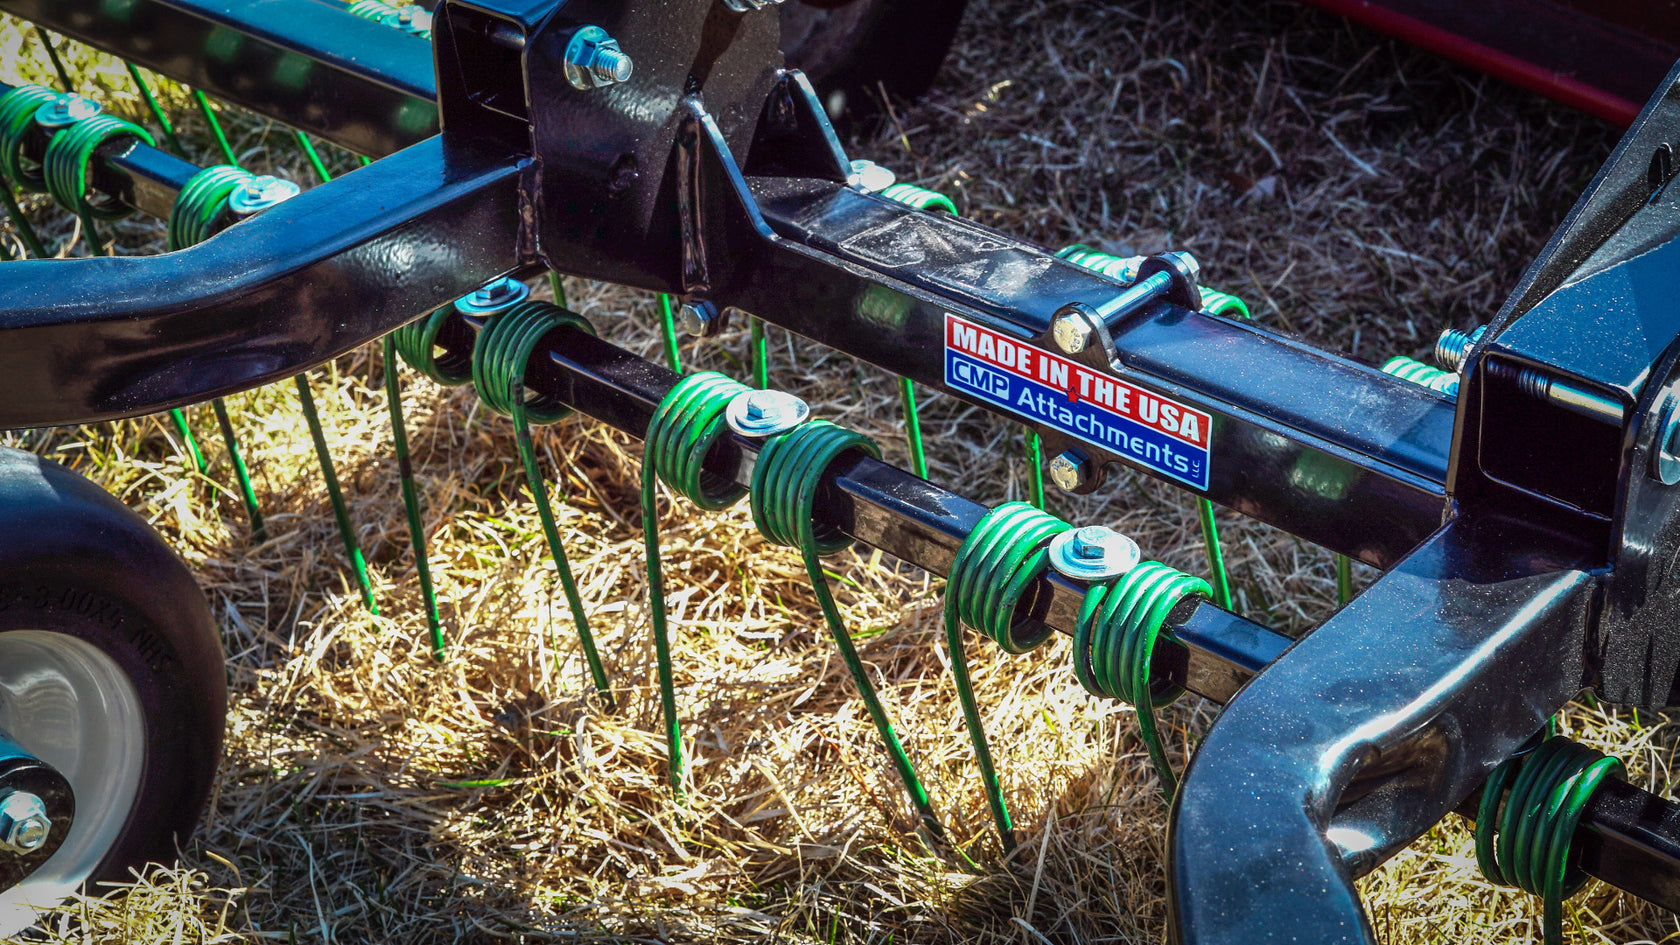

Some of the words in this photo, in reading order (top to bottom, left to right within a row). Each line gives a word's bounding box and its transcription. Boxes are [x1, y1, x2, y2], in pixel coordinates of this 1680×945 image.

[953, 322, 1032, 375] MADE
[1039, 355, 1068, 389] IN
[1076, 370, 1131, 414] THE
[1138, 395, 1201, 443] USA
[953, 359, 1009, 397] CMP
[1017, 387, 1190, 473] Attachments
